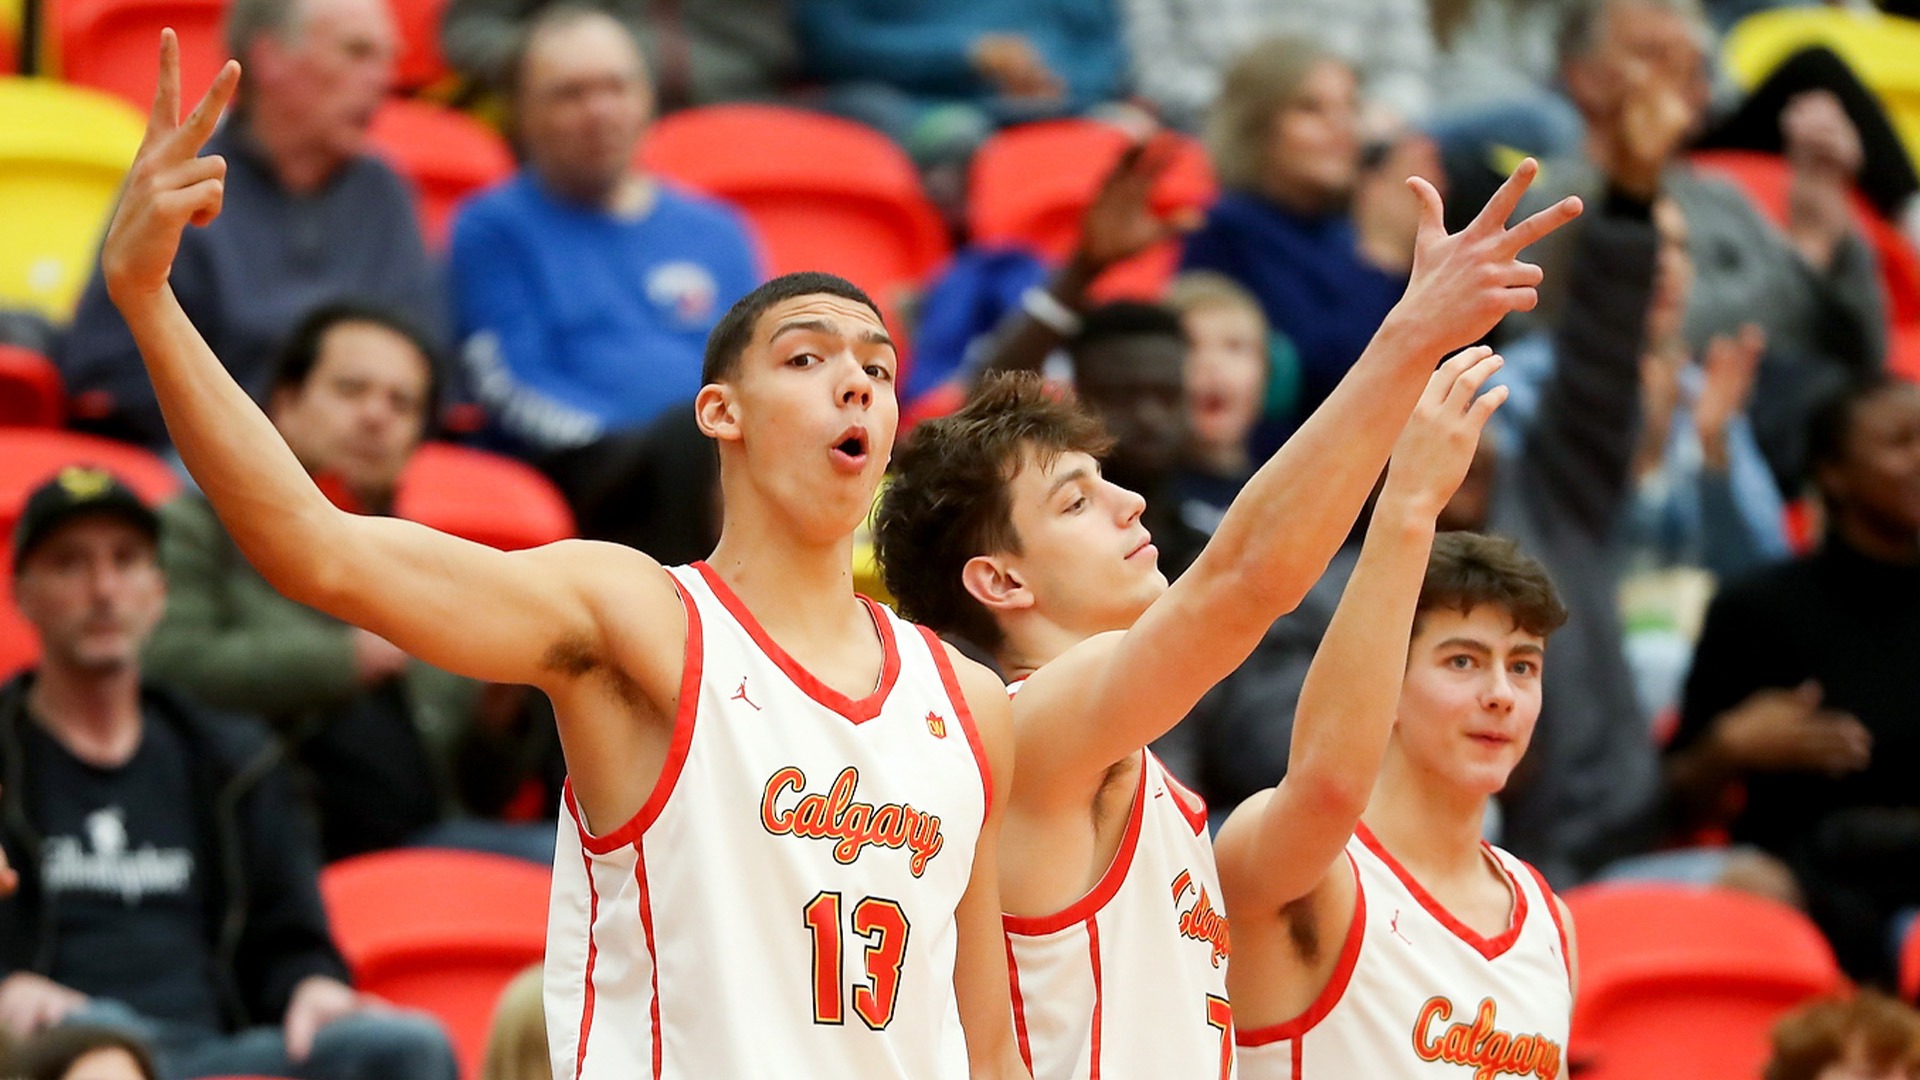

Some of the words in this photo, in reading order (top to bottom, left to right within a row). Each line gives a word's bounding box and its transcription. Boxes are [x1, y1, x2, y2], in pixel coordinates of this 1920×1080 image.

[761, 766, 943, 878] Calgary
[803, 890, 910, 1031] 13
[1412, 996, 1561, 1080] Calgary
